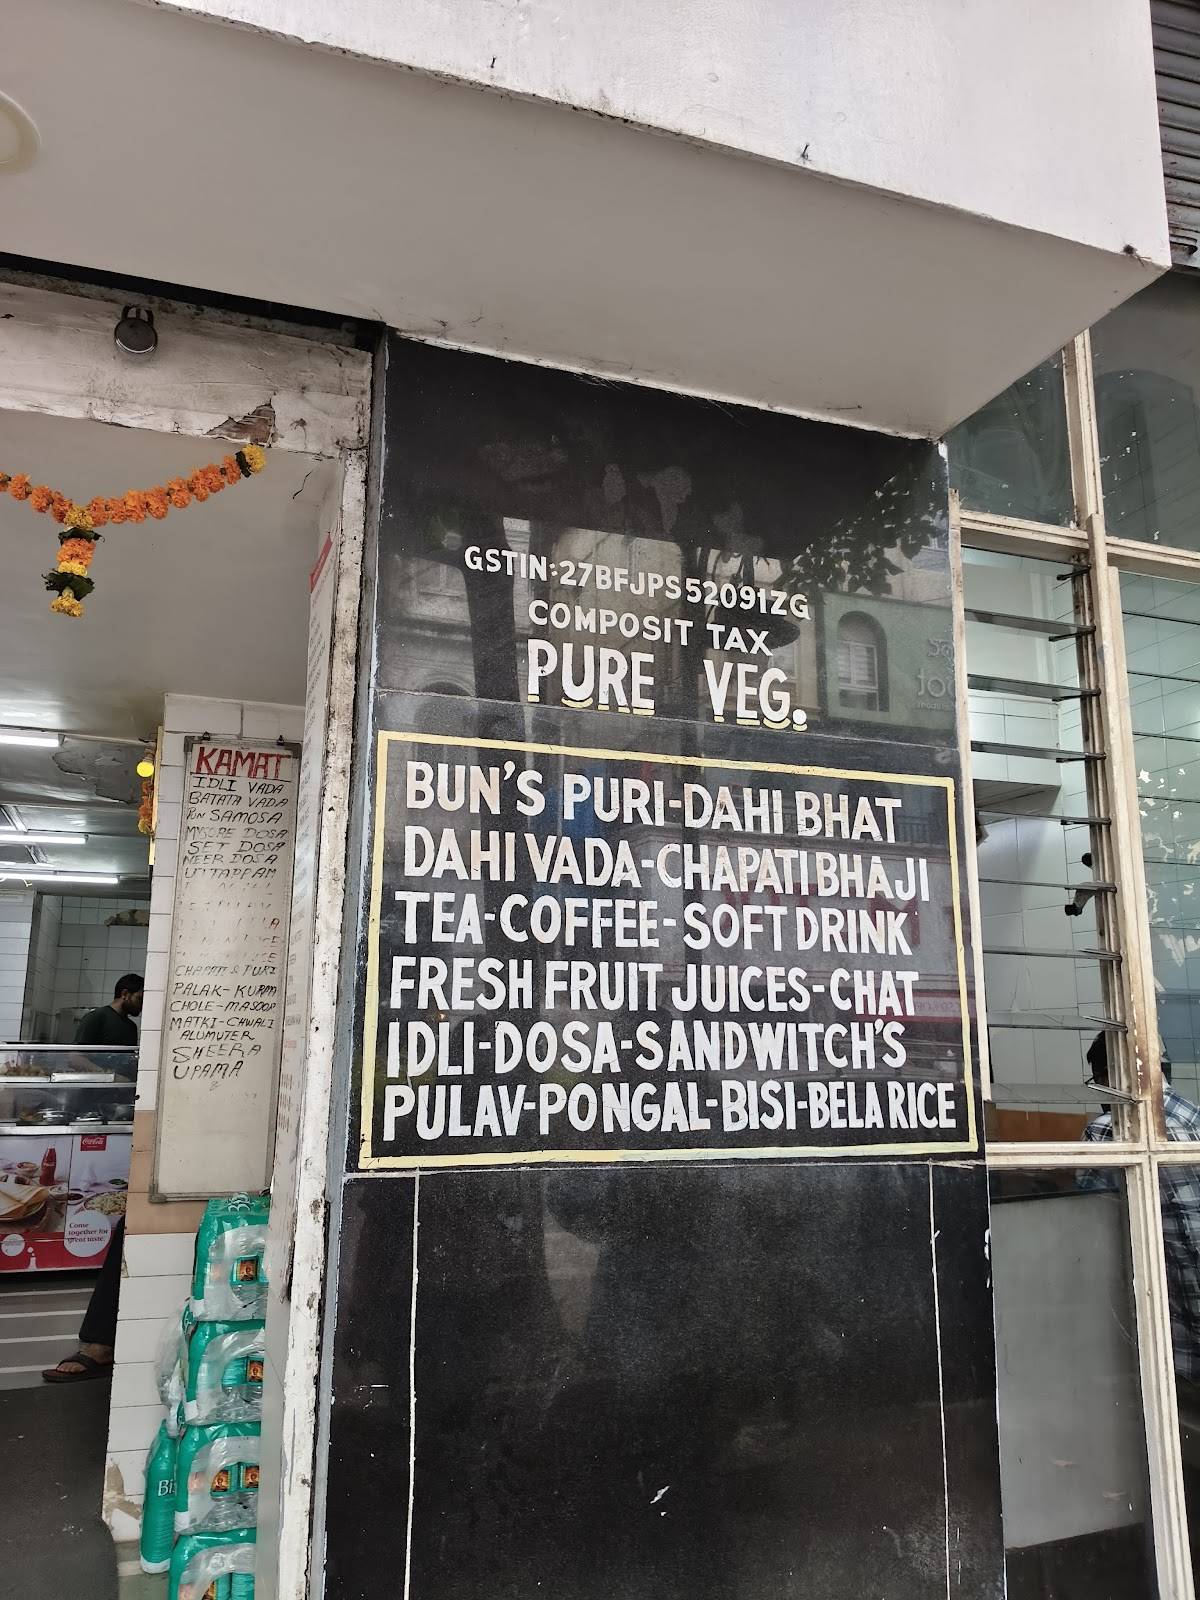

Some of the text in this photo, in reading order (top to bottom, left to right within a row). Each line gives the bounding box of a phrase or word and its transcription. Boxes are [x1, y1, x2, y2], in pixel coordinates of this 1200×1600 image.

[528, 599, 773, 657] COMPOSIT TAX
[528, 638, 808, 728] PURE VEG.
[196, 747, 291, 779] KAMAT
[189, 791, 289, 808] BATATA VADA
[193, 776, 285, 795] IDLI VADA
[210, 809, 283, 824] SAMOSA
[406, 761, 902, 843] BUN'S PURI-DAHI BHAT
[188, 841, 286, 855] SET DOSA
[242, 827, 288, 839] DOSA
[404, 826, 515, 882] DAHI
[816, 852, 930, 902] BHAJI
[797, 906, 912, 956] DRINK
[390, 956, 920, 1017] FRESH FRUIT JUICES-CHAT
[172, 1043, 262, 1063] SHEERA
[173, 1060, 244, 1080] UPAMA
[889, 1081, 957, 1129] RICE
